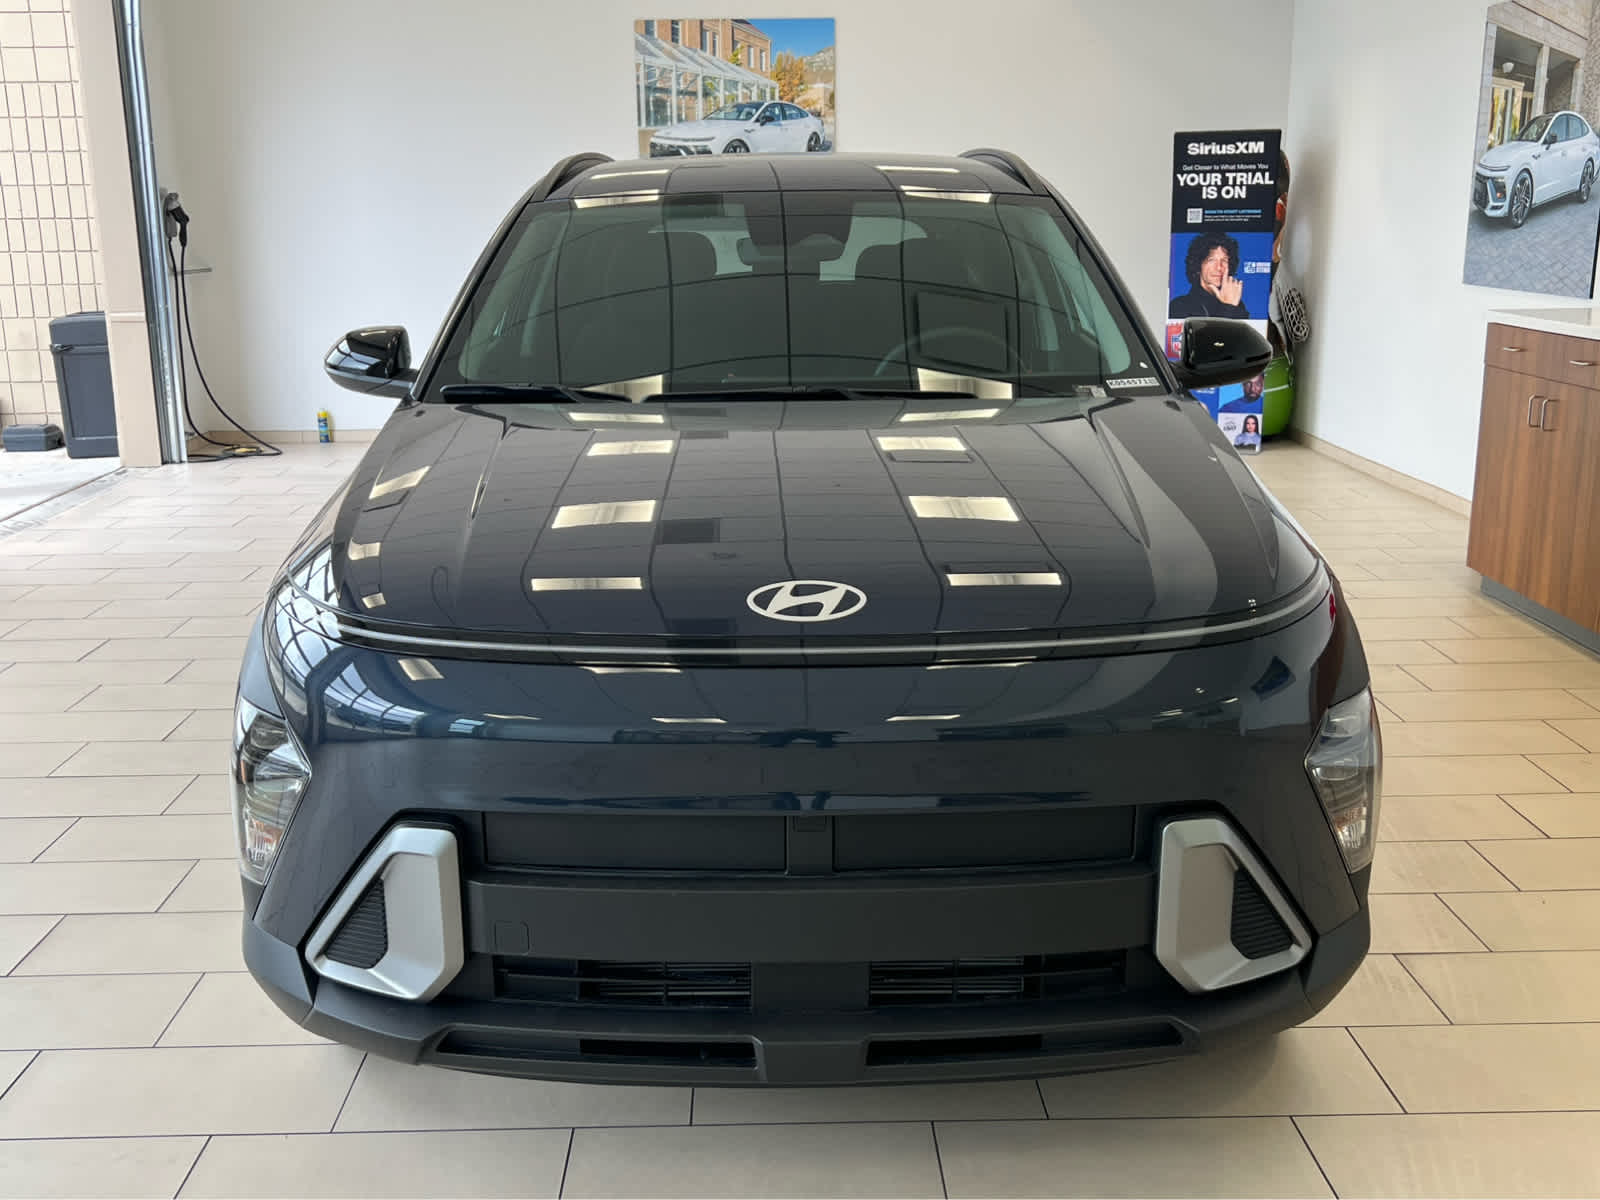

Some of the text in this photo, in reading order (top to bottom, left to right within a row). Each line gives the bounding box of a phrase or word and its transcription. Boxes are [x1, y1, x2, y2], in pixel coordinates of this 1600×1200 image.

[1187, 141, 1264, 155] SiriusXM
[1176, 171, 1274, 187] YOUR TRIAL
[1202, 185, 1247, 199] IS ON
